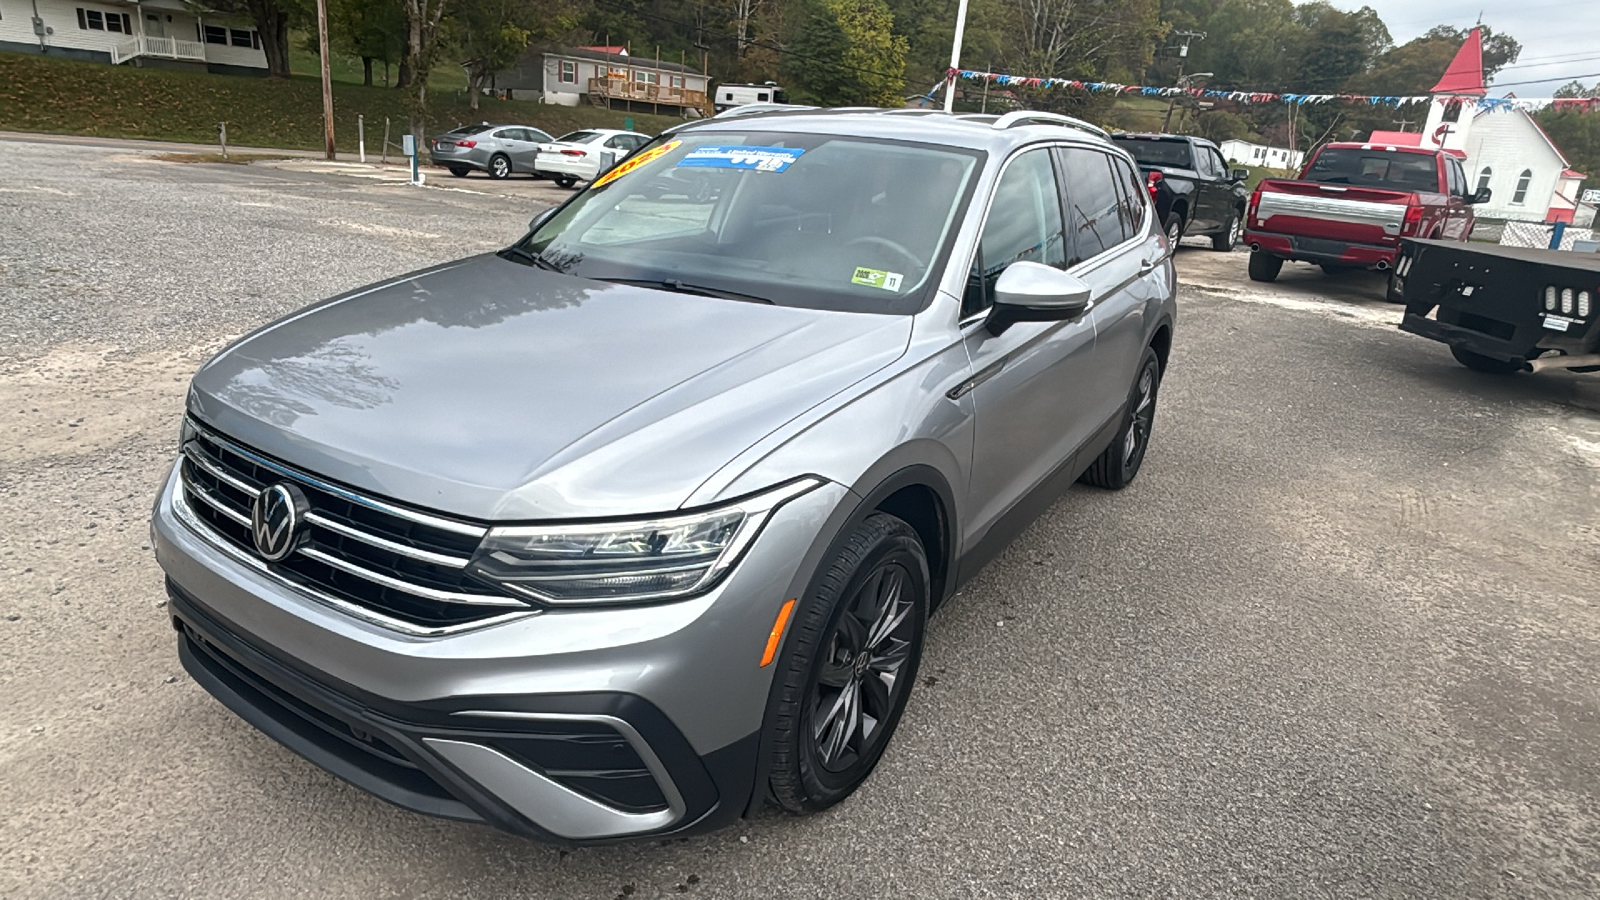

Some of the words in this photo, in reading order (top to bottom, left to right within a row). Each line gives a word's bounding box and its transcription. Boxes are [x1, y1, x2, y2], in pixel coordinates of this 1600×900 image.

[600, 144, 672, 182] 2023
[726, 149, 756, 157] Limited
[755, 150, 794, 158] Warranty
